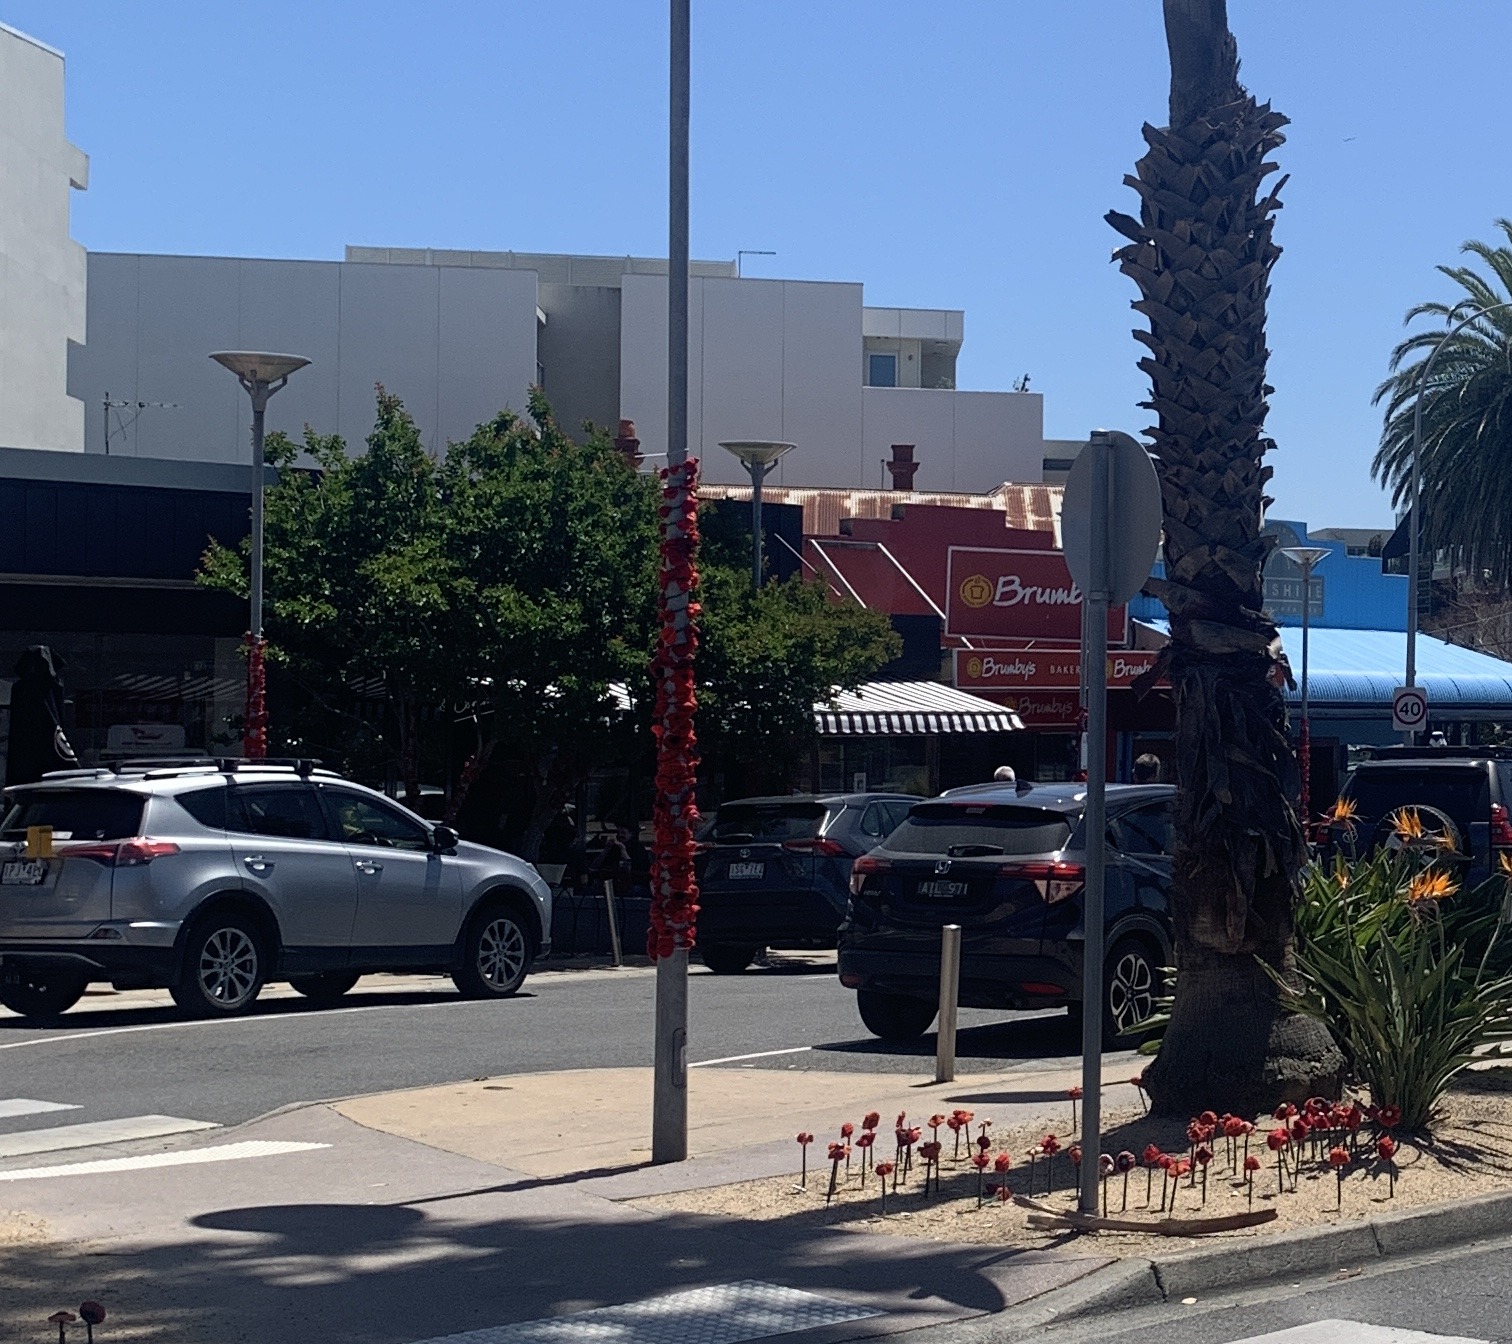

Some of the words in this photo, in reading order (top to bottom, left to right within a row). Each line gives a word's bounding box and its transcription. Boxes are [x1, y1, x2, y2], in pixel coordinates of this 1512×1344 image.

[992, 574, 1083, 607] Brumb
[981, 656, 1036, 683] Brumby's
[1049, 664, 1083, 675] BAKER
[1016, 696, 1073, 719] Brumby's
[1398, 702, 1421, 716] 40
[948, 882, 968, 895] 971
